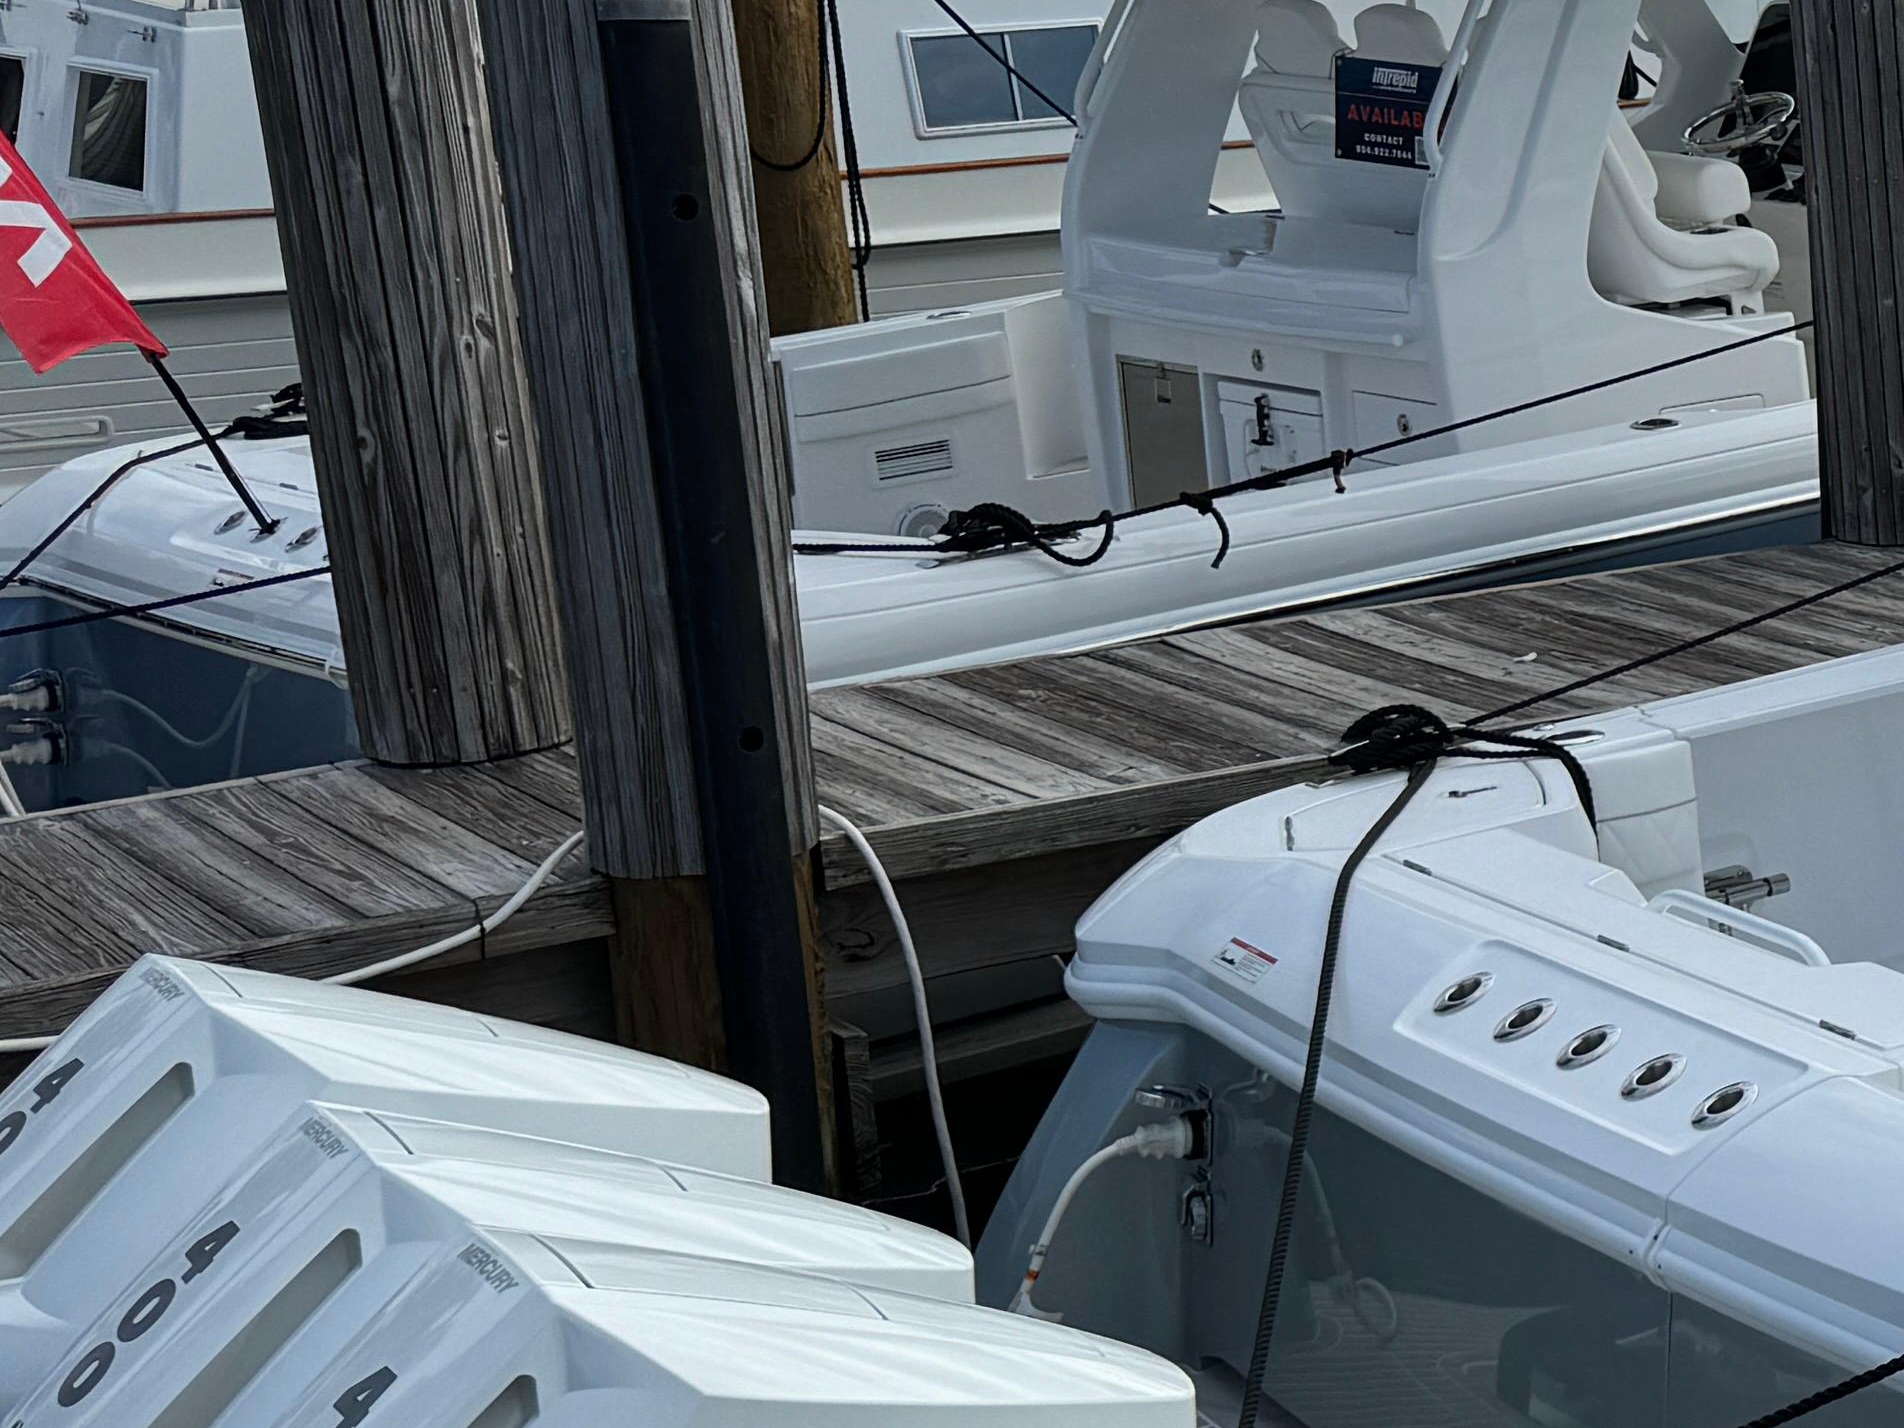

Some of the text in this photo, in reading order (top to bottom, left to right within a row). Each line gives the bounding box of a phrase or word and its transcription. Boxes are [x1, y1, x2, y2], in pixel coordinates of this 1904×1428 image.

[1347, 103, 1425, 129] AVAILAB
[1364, 132, 1404, 145] CONTACT
[456, 1242, 520, 1294] MERCURY
[57, 1220, 240, 1408] 400
